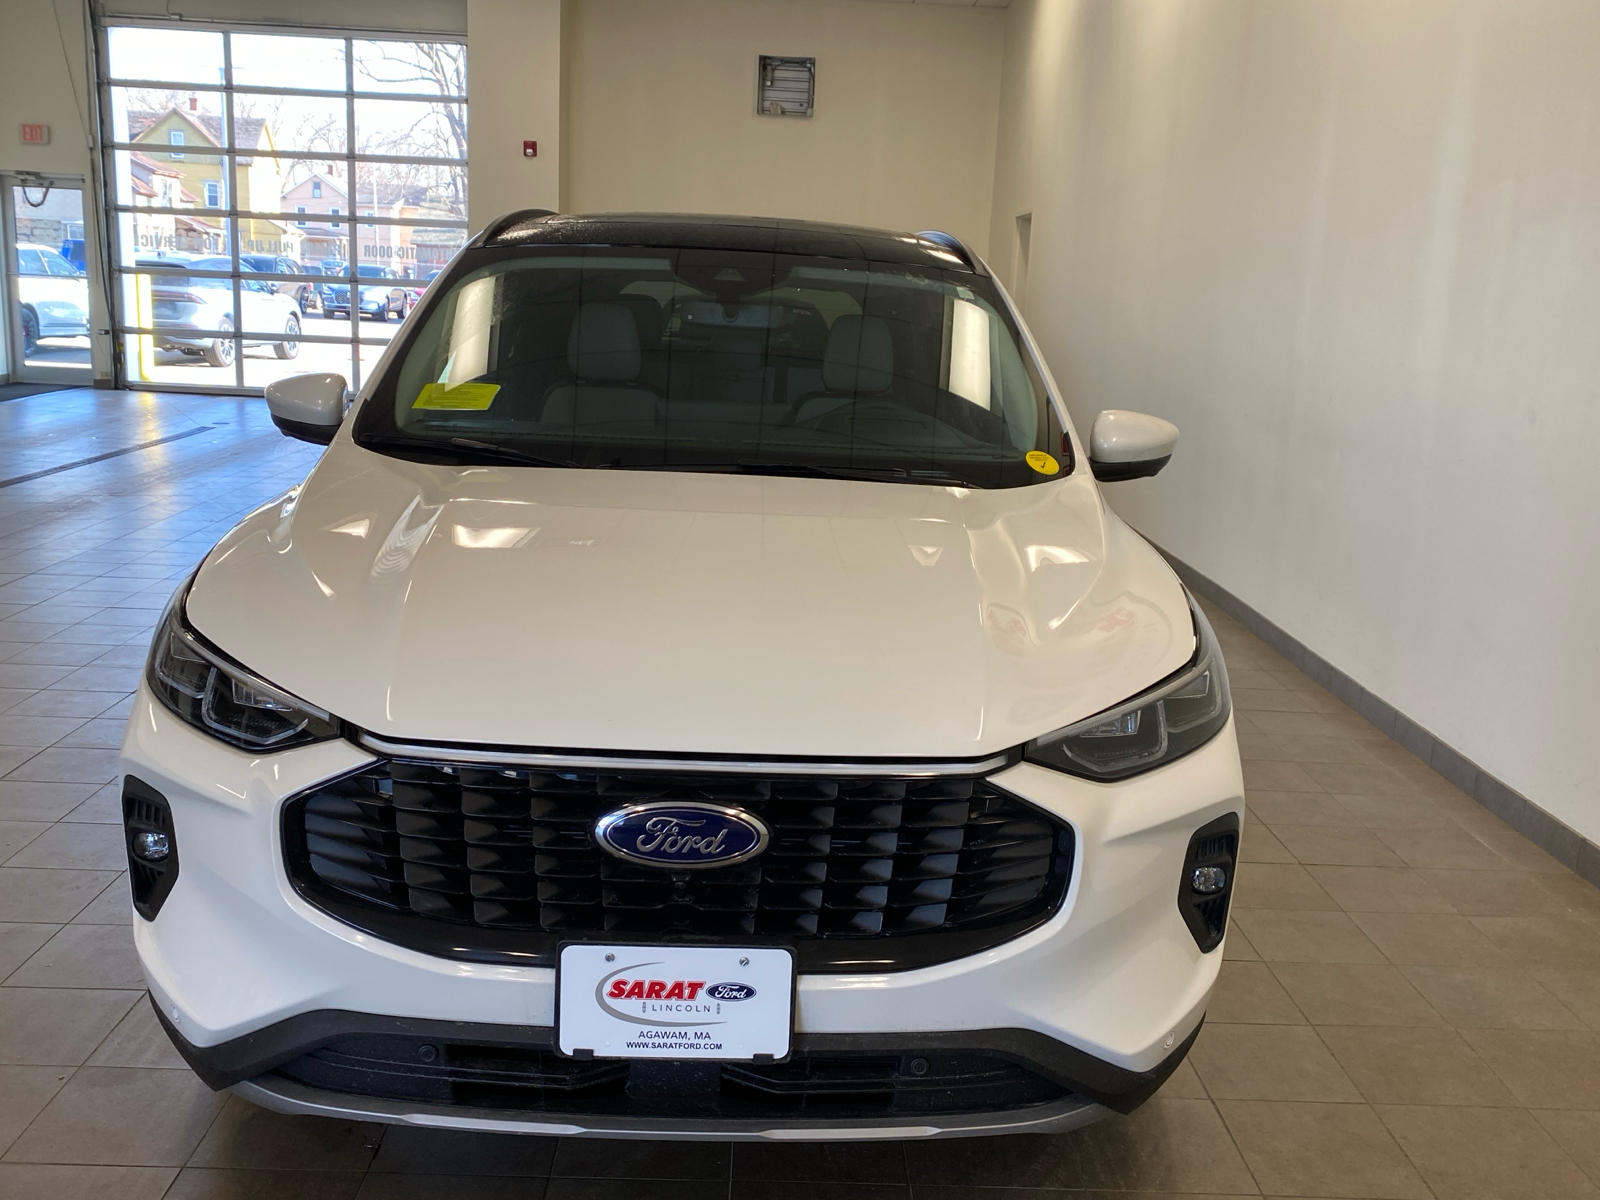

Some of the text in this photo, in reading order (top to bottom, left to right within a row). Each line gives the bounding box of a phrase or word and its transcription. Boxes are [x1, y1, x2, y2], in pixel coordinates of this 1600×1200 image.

[636, 816, 730, 855] Ford
[606, 978, 748, 1001] SARAT Ford
[651, 1003, 712, 1014] LINCOLN
[638, 1030, 711, 1042] AGAWAM, MA
[626, 1041, 723, 1051] WWW.SARATFORD.COM
